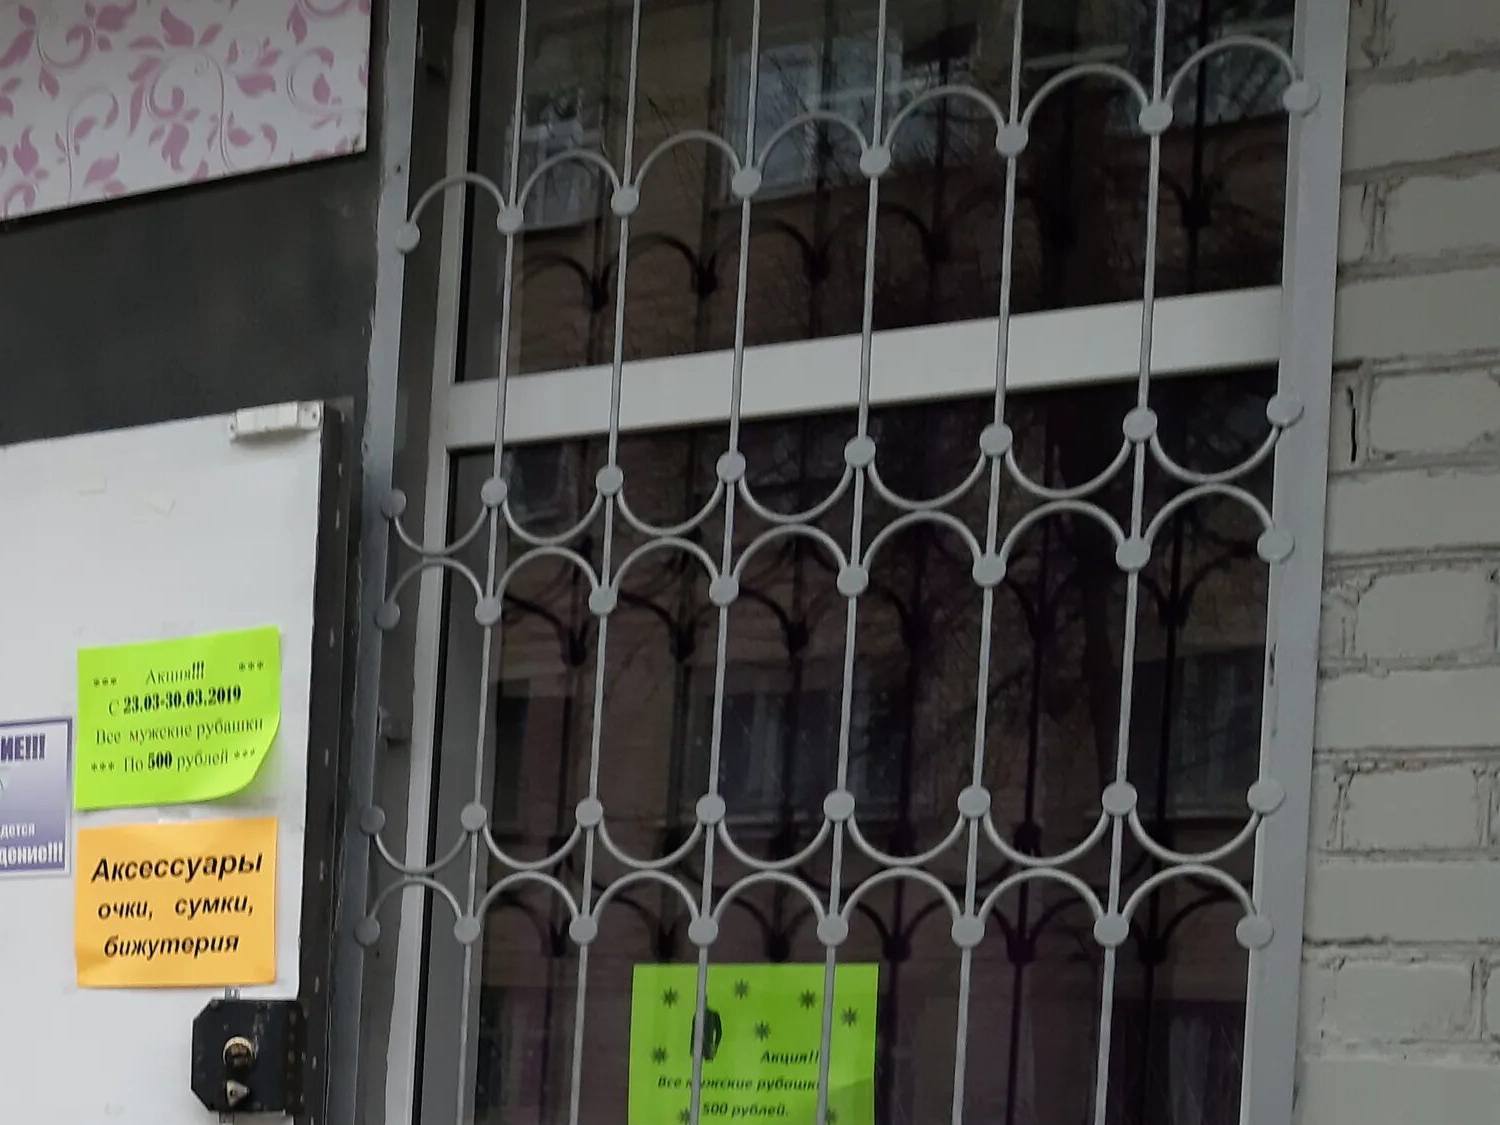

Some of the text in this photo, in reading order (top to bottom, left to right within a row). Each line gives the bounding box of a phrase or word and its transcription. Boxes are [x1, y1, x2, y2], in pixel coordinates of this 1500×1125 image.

[146, 661, 205, 686] Акция!!!
[123, 685, 242, 715] 23.03-30.03.2019
[96, 717, 263, 746] Все мужские рубашки
[124, 748, 228, 773] По 500 рублей
[90, 853, 263, 884] Аксессуары
[98, 895, 253, 920] очки, сумки,
[104, 934, 239, 960] бижутерия
[658, 1075, 682, 1088] Все
[702, 1103, 728, 1116] 500
